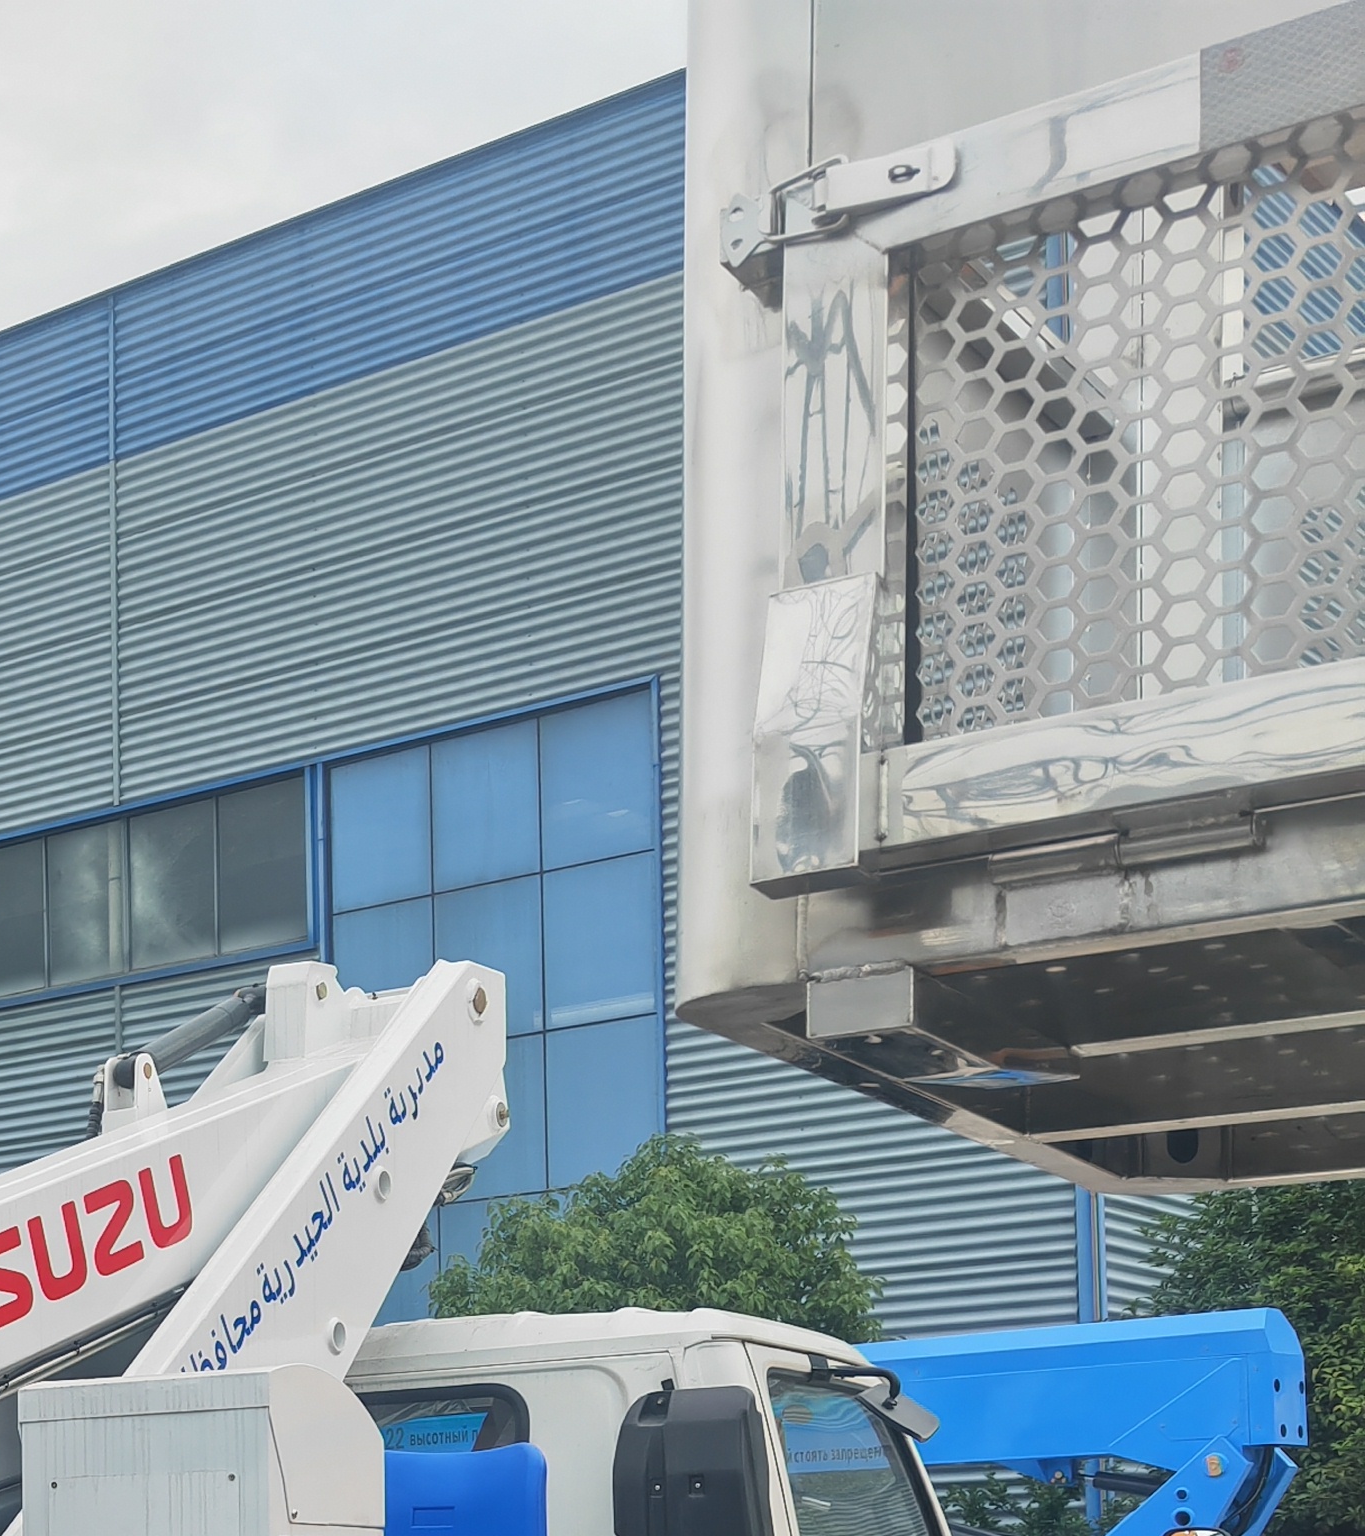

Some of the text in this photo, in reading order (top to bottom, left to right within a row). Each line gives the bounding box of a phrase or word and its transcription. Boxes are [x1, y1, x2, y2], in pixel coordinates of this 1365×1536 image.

[337, 1115, 390, 1194] بلدية
[255, 1171, 341, 1306] الحيدرية
[180, 1299, 262, 1373] محافظ
